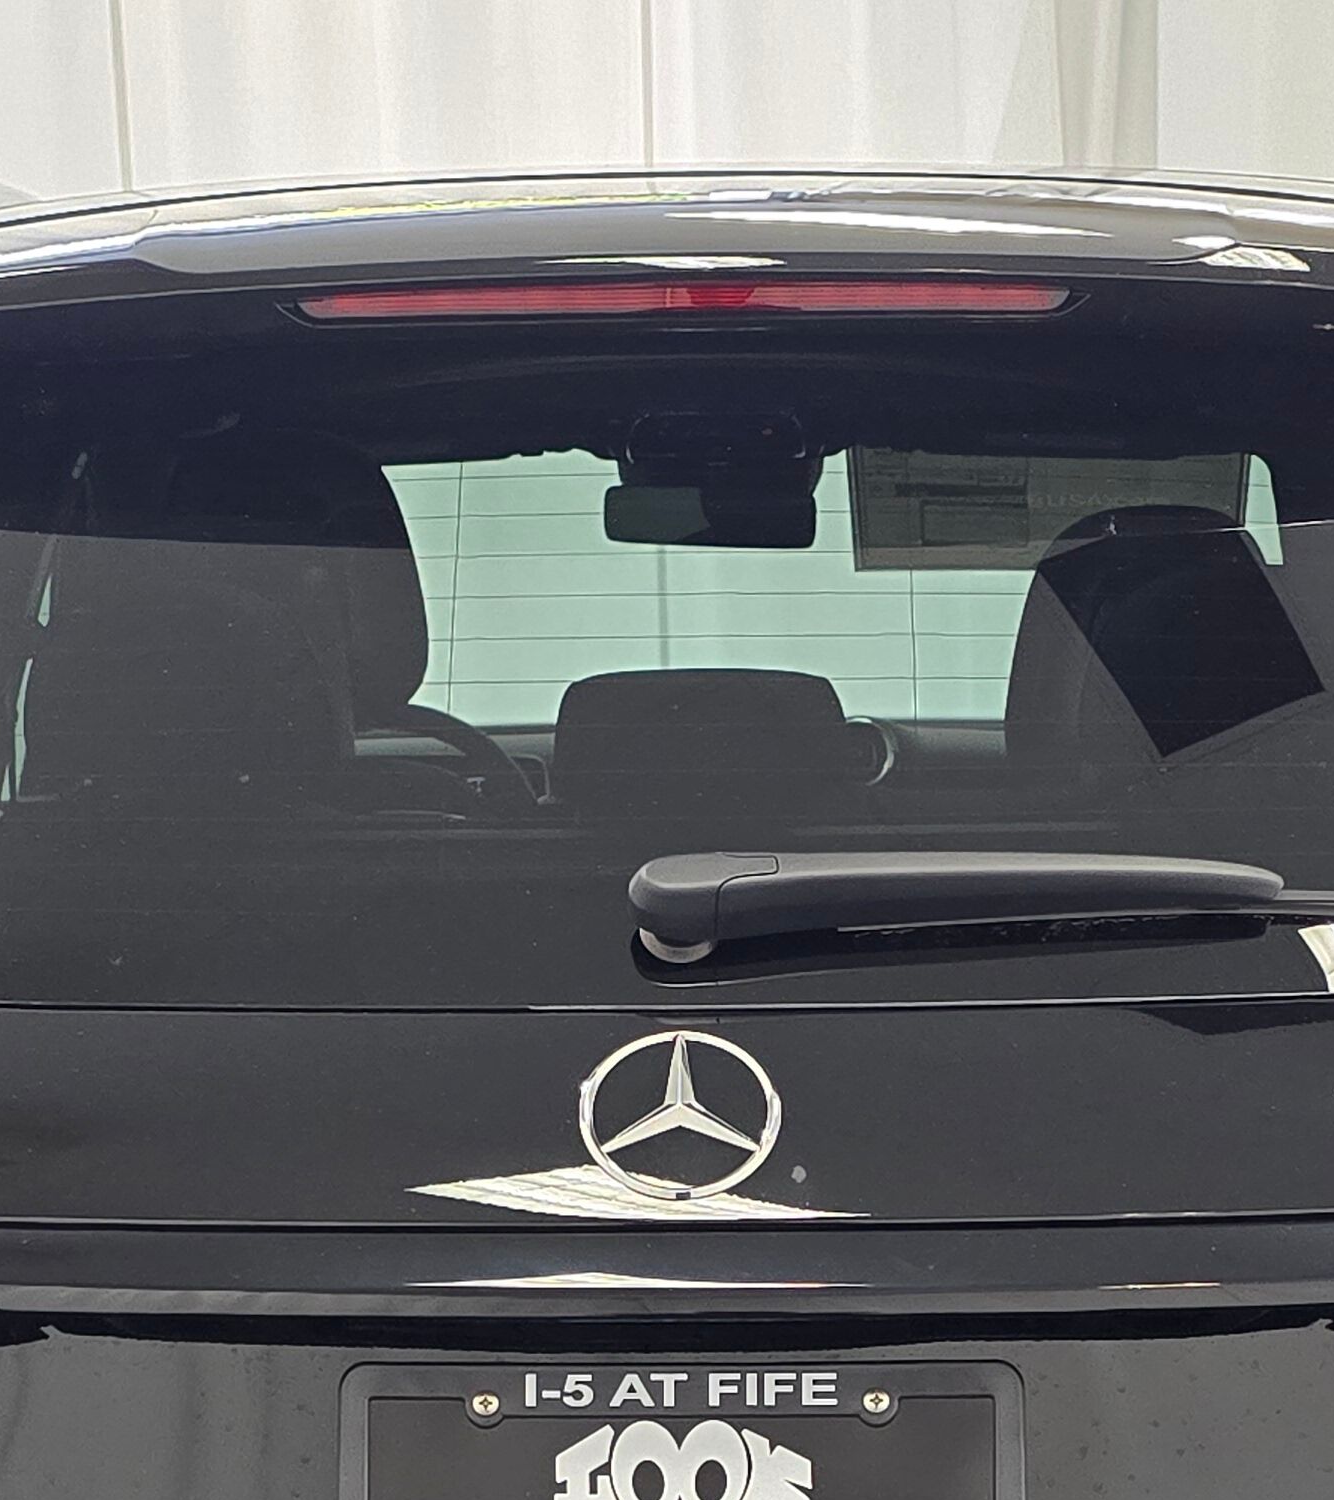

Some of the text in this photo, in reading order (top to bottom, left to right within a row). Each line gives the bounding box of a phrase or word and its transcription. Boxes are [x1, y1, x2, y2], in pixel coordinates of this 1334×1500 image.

[524, 1372, 839, 1408] I-5 AT FIFE
